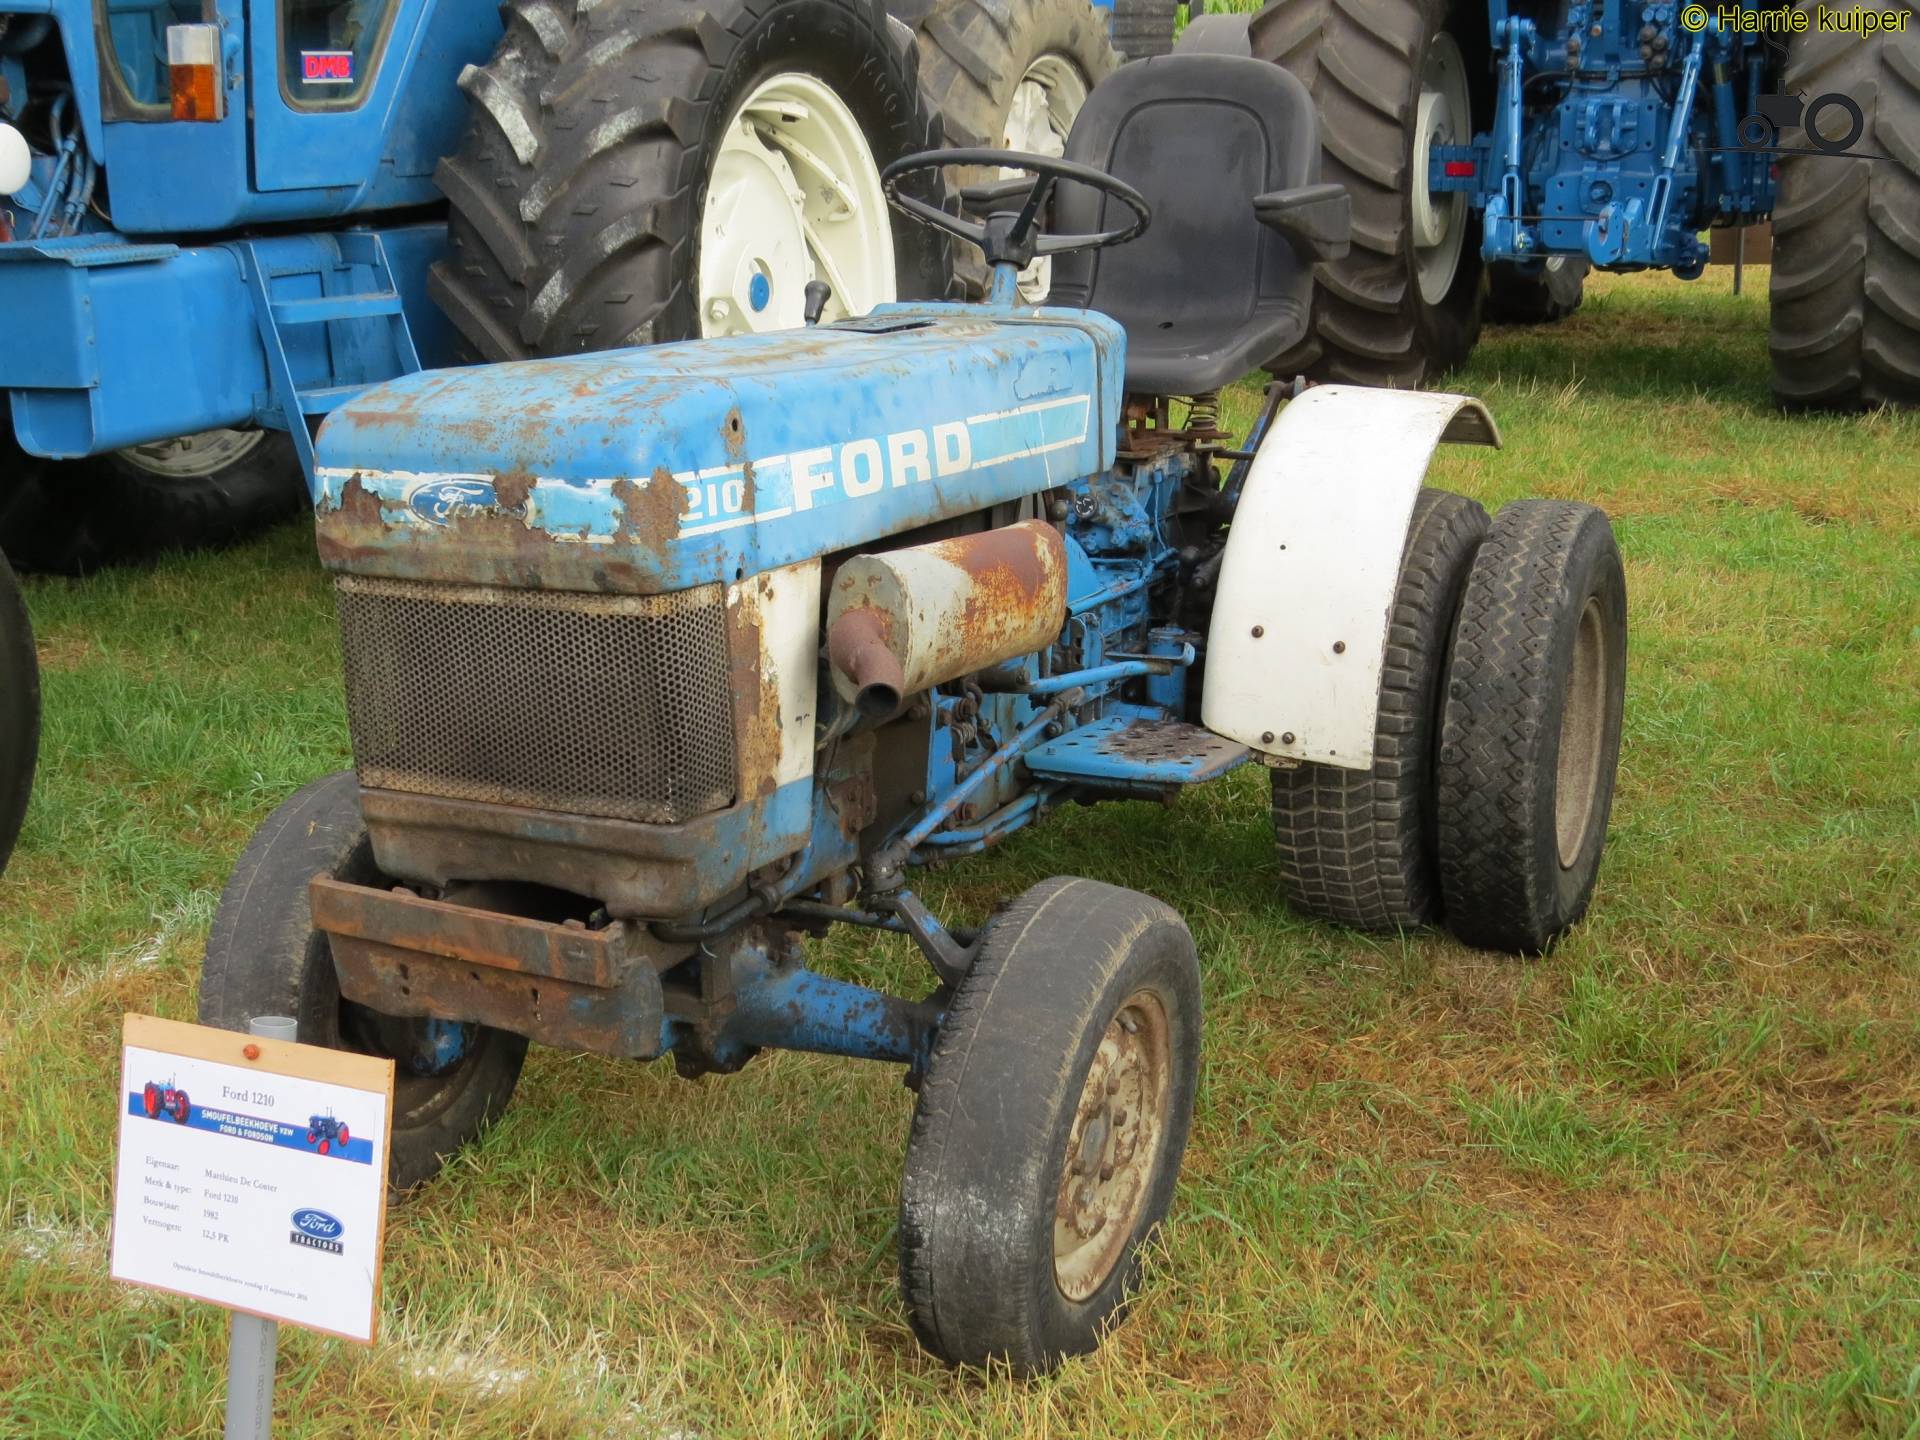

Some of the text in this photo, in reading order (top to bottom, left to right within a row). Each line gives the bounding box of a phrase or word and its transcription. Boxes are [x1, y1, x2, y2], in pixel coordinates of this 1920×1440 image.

[788, 420, 973, 513] FORD
[222, 1086, 275, 1107] Ford 1210
[201, 1109, 279, 1133] SMOUFELBEEKHOEVE
[219, 1124, 237, 1135] FORD
[243, 1128, 274, 1143] FORDSON
[145, 1155, 180, 1170] Eigenaar:
[144, 1175, 164, 1187] Merk
[239, 1176, 252, 1187] De
[143, 1195, 180, 1211] Bouwjaar:
[203, 1188, 222, 1201] Ford
[142, 1215, 183, 1232] Vermogen:
[299, 1213, 336, 1232] Ford
[295, 1234, 340, 1252] TRACTORS
